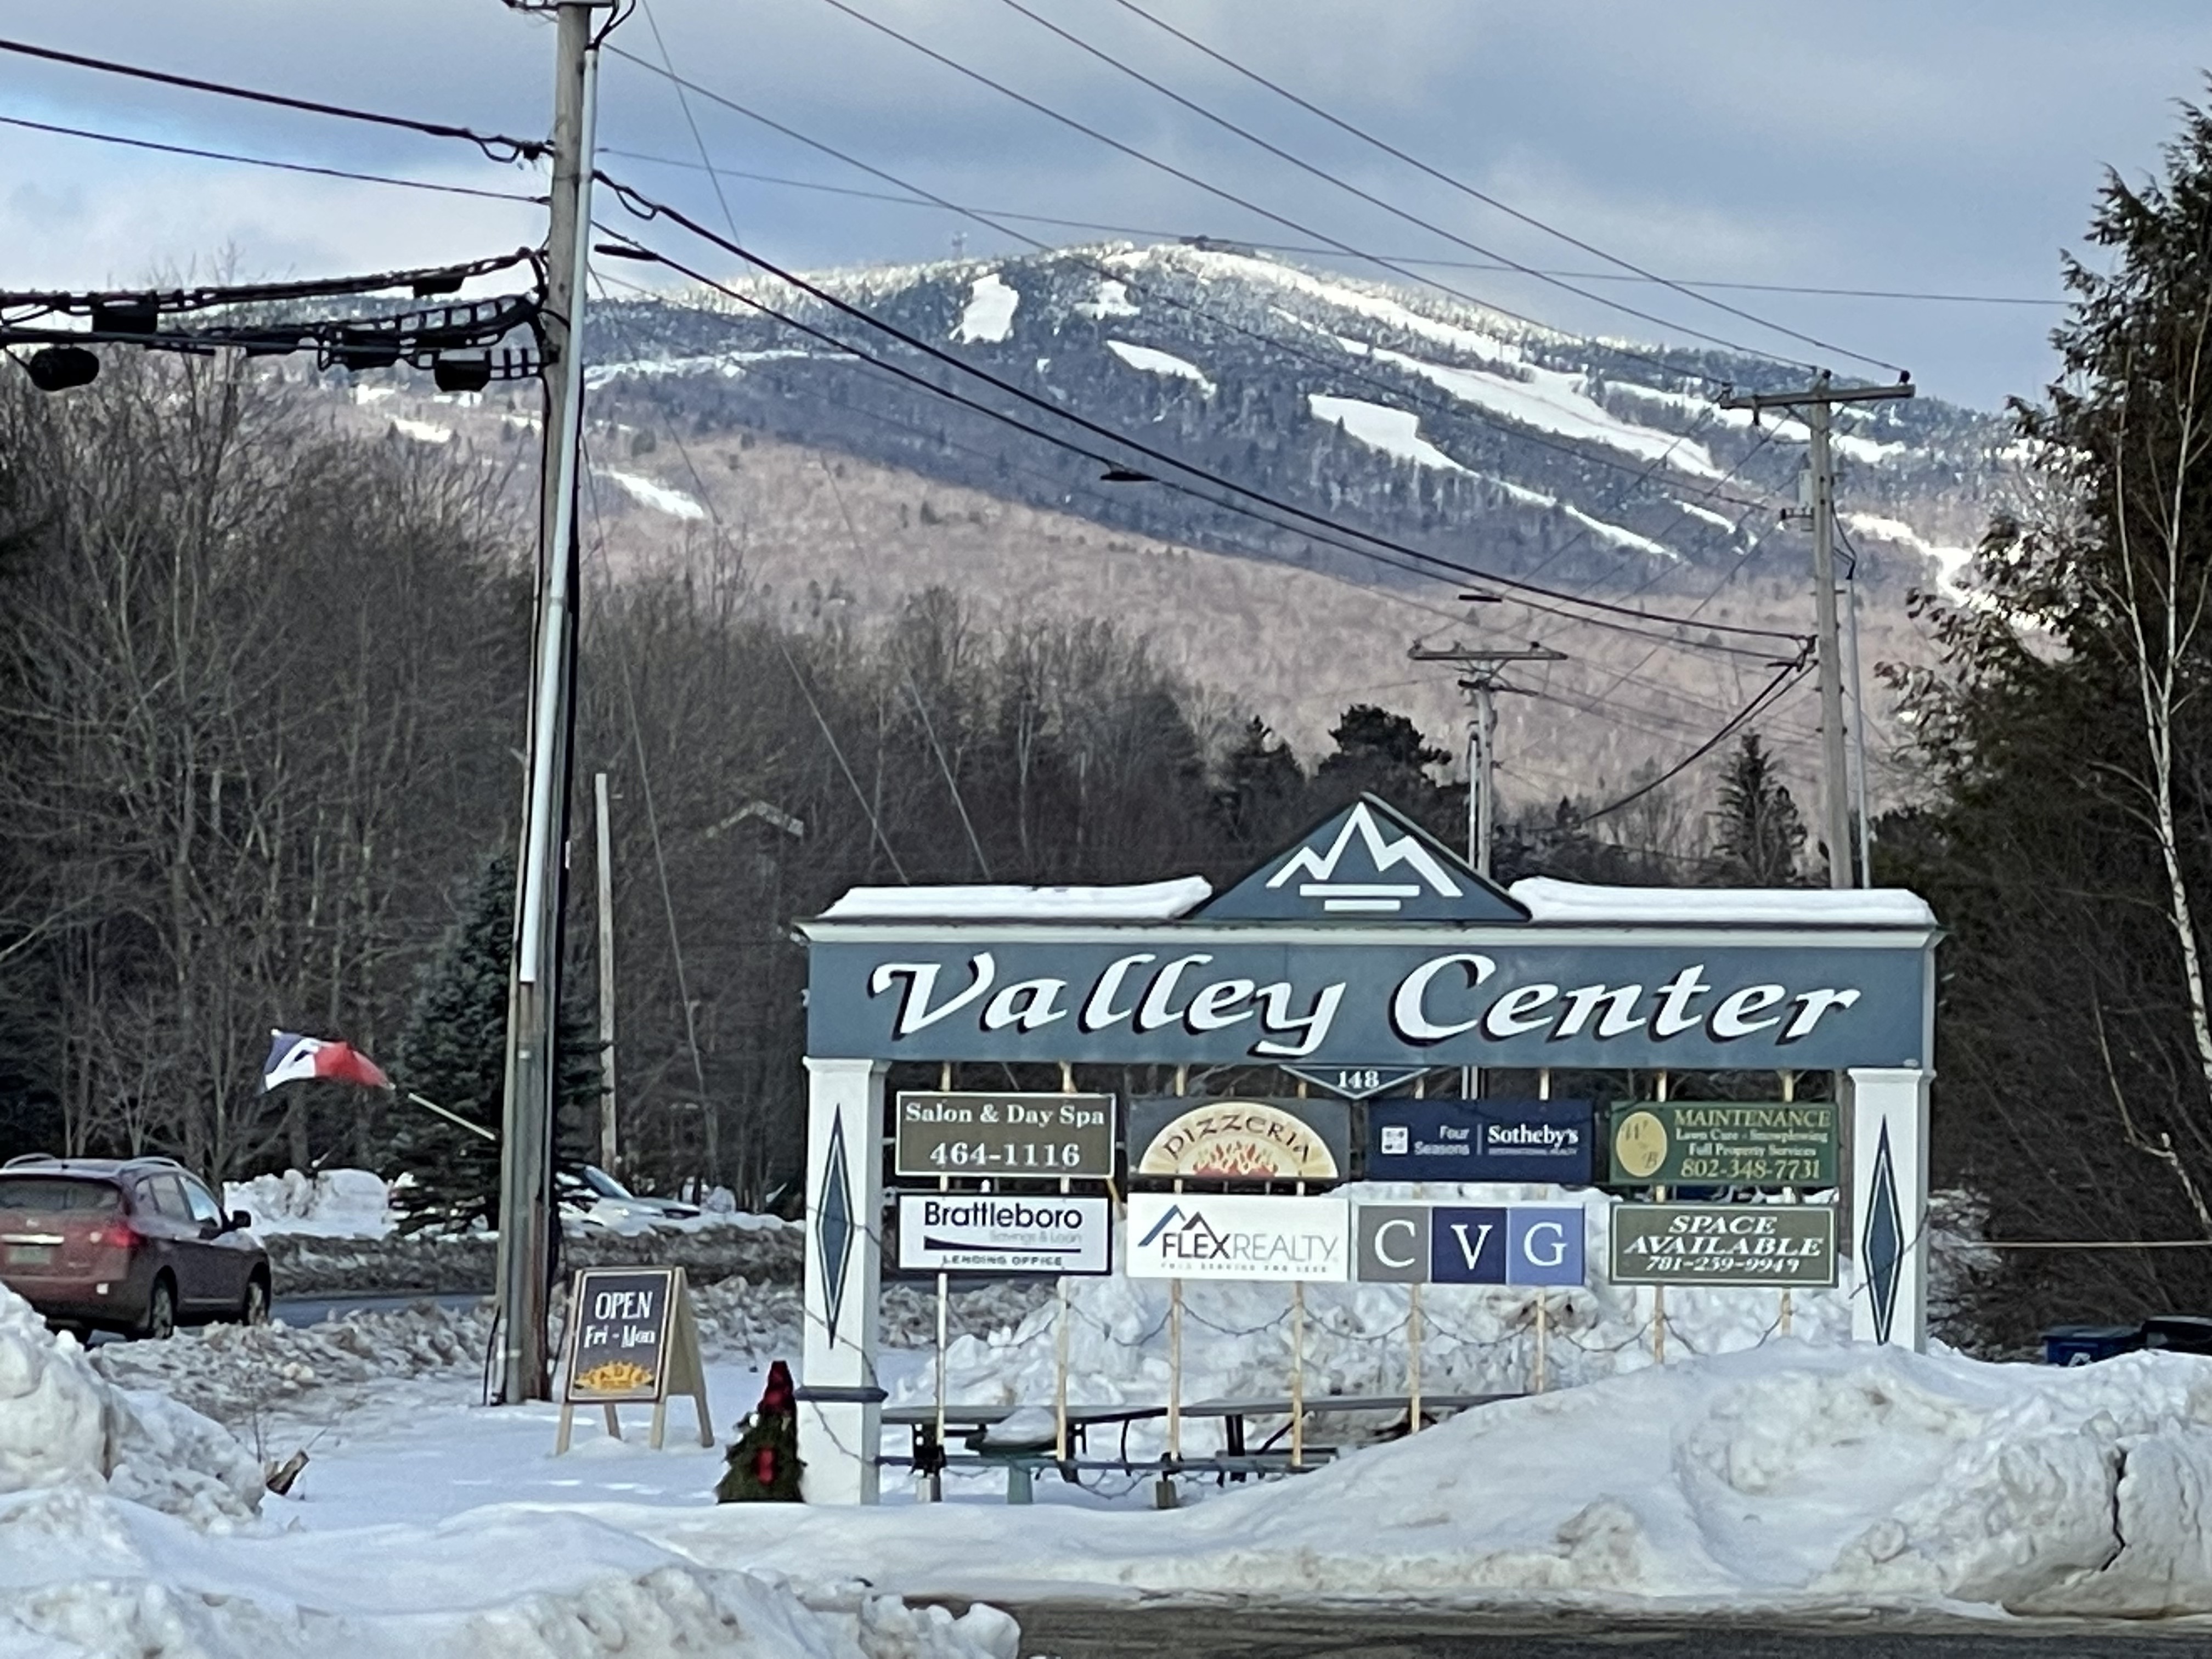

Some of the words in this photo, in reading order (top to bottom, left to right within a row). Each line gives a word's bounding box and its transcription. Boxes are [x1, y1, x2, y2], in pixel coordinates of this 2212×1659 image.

[870, 951, 1346, 1058] Valley
[1390, 953, 1861, 1047] Center
[1339, 1070, 1380, 1088] 148
[905, 1102, 973, 1122] Salon
[980, 1103, 1000, 1123] &
[1007, 1104, 1053, 1128] Day
[1059, 1104, 1105, 1128] Spa
[1674, 1109, 1831, 1127] MAINTENANCE
[1162, 1114, 1312, 1164] PIZZERIA
[1440, 1125, 1470, 1140] Four
[1487, 1123, 1579, 1148] Sotheby's
[1709, 1128, 1739, 1141] Care
[929, 1142, 1081, 1167] 464-1116
[1413, 1141, 1470, 1156] Seasons
[1689, 1144, 1713, 1156] Full
[1768, 1144, 1816, 1156] Services
[1680, 1158, 1820, 1180] 802-348-7731
[924, 1200, 1083, 1229] Brattleboro
[1668, 1215, 1778, 1234] SPACE
[1050, 1231, 1082, 1243] Loan
[1623, 1235, 1824, 1257] AVAILABLE
[943, 1255, 1007, 1266] LENDING
[1012, 1256, 1063, 1267] OFFICE
[595, 1291, 653, 1319] OPEN
[584, 1325, 609, 1348] Fri
[620, 1325, 656, 1348] Mon
